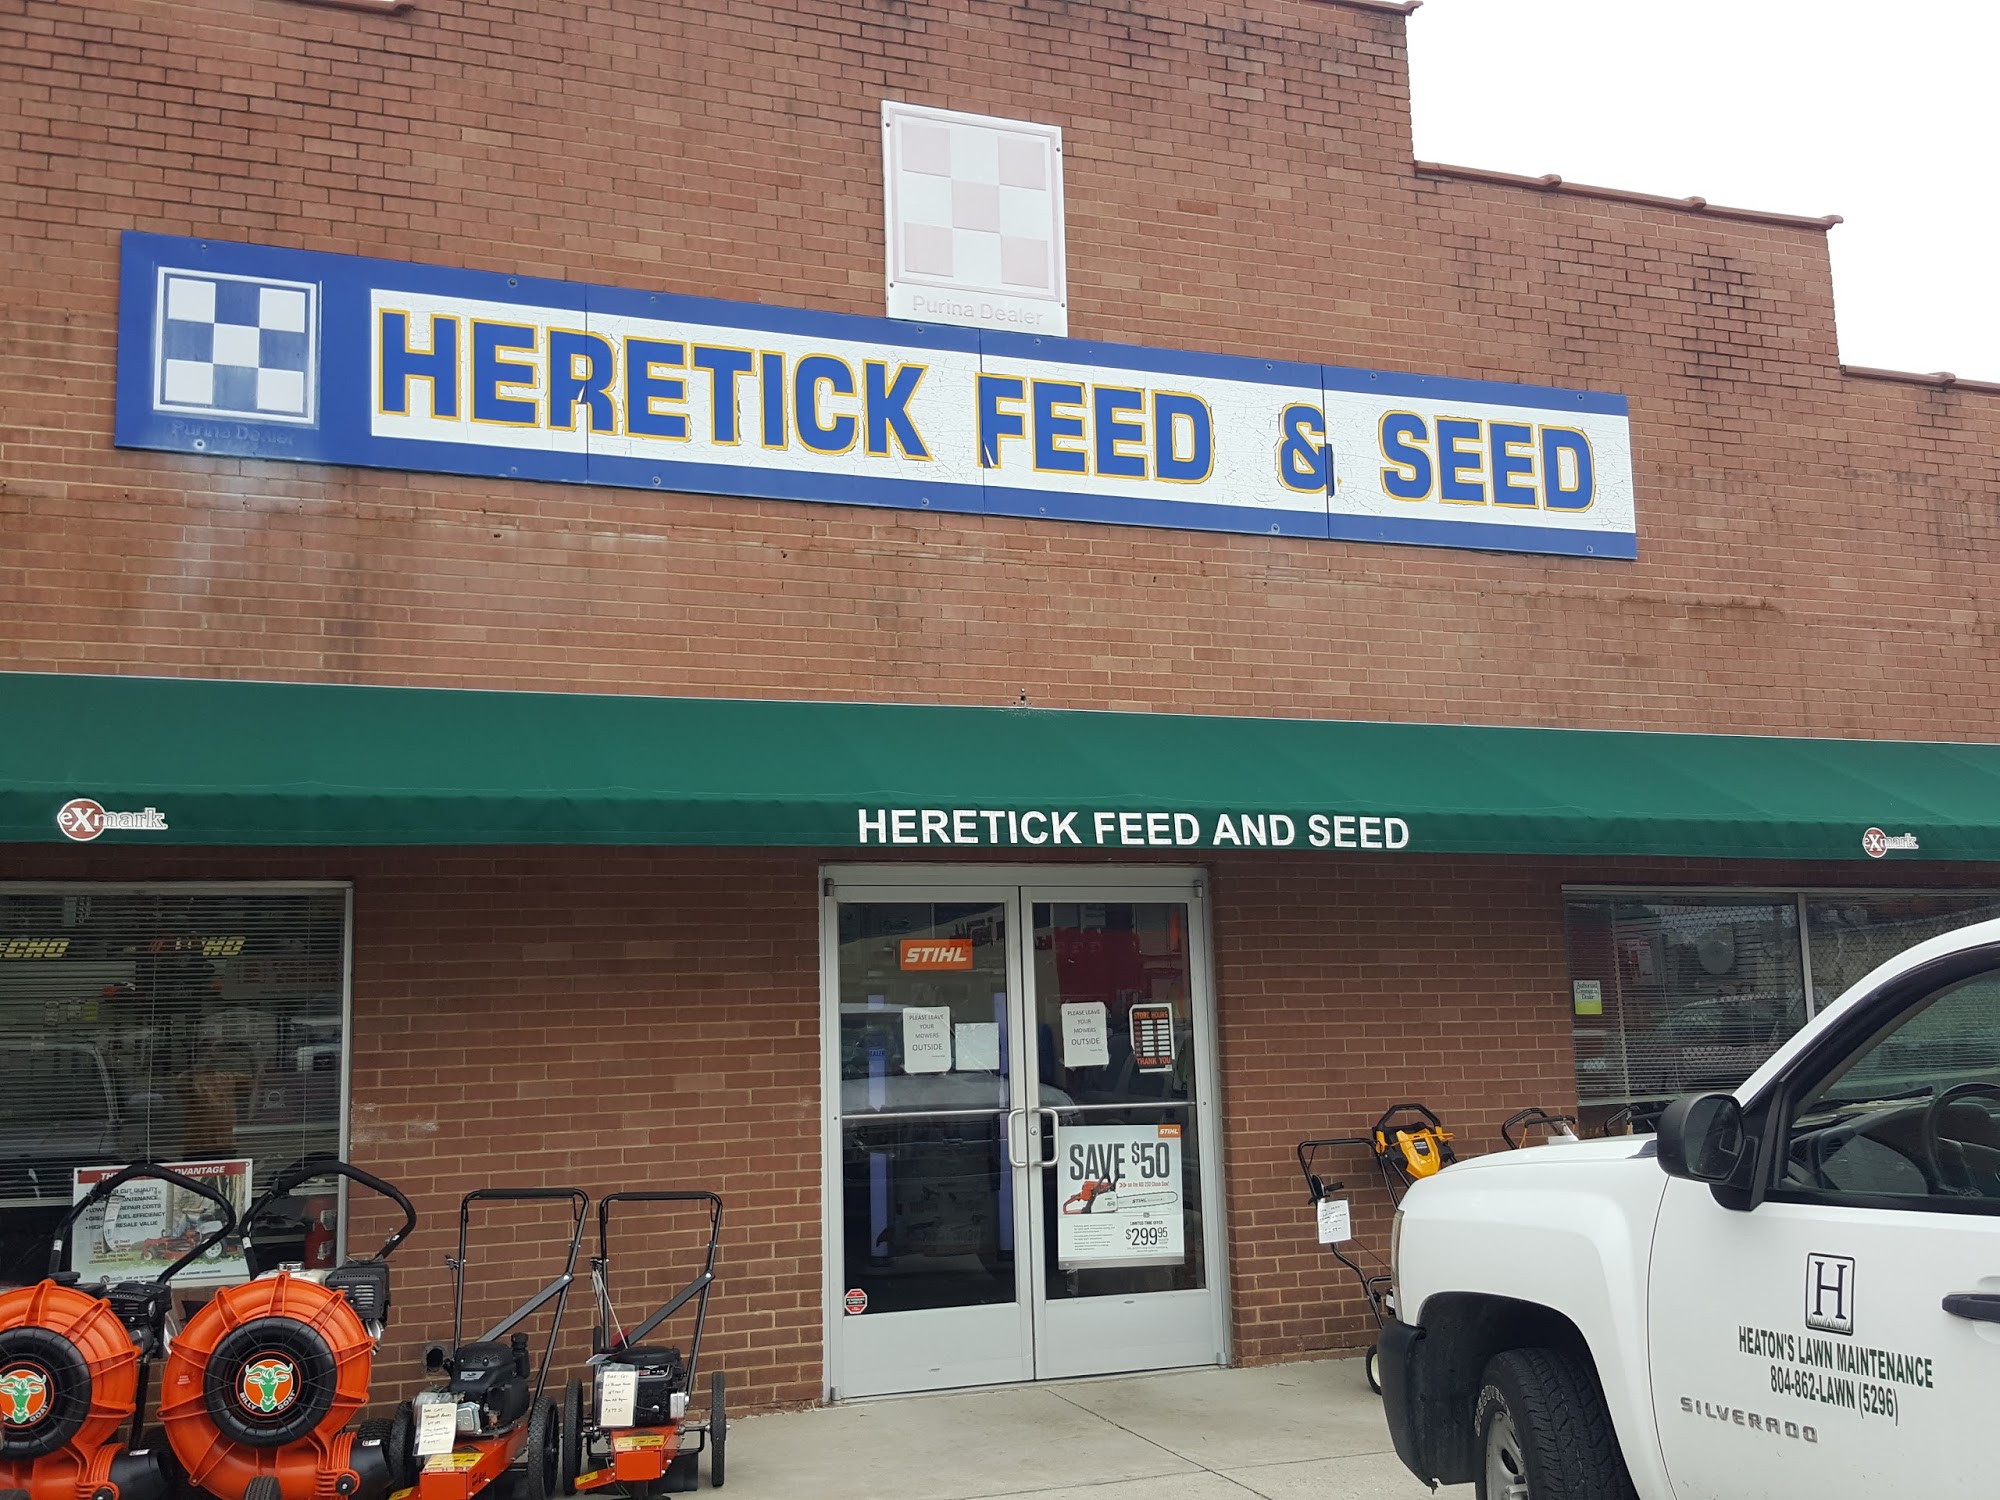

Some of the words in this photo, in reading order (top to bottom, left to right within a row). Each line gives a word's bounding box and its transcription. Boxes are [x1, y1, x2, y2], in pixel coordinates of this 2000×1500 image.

[912, 294, 974, 318] Purina
[979, 303, 1043, 325] Dealer
[378, 307, 933, 461] HERETICK
[975, 371, 1214, 484] FEED
[1277, 402, 1333, 493] &
[1378, 409, 1596, 513] SEED
[858, 808, 1082, 845] HERETICK
[1093, 811, 1200, 846] FEED
[1213, 813, 1295, 847] AND
[1308, 815, 1409, 849] SEED
[905, 947, 967, 963] STIHL
[1151, 1010, 1169, 1019] HOURS
[912, 1043, 943, 1051] OUTSIDE
[1071, 1038, 1100, 1046] OUTSIDE
[1136, 1057, 1157, 1066] THANK
[1159, 1056, 1172, 1064] YOU
[1069, 1143, 1125, 1180] SAVE
[1131, 1141, 1170, 1179] $50
[1812, 1261, 1848, 1320] H
[1739, 1325, 1795, 1362] HEATON'S
[1799, 1336, 1832, 1370] LAWN
[1836, 1342, 1934, 1389] MAINTENANCE
[240, 1392, 257, 1410] BILLY
[278, 1390, 295, 1410] GOAT
[1771, 1365, 1855, 1410] 804-862-LAWN
[1858, 1382, 1899, 1426] (5296)
[29, 1402, 49, 1422] GOAT
[1680, 1396, 1818, 1443] SILVERADO
